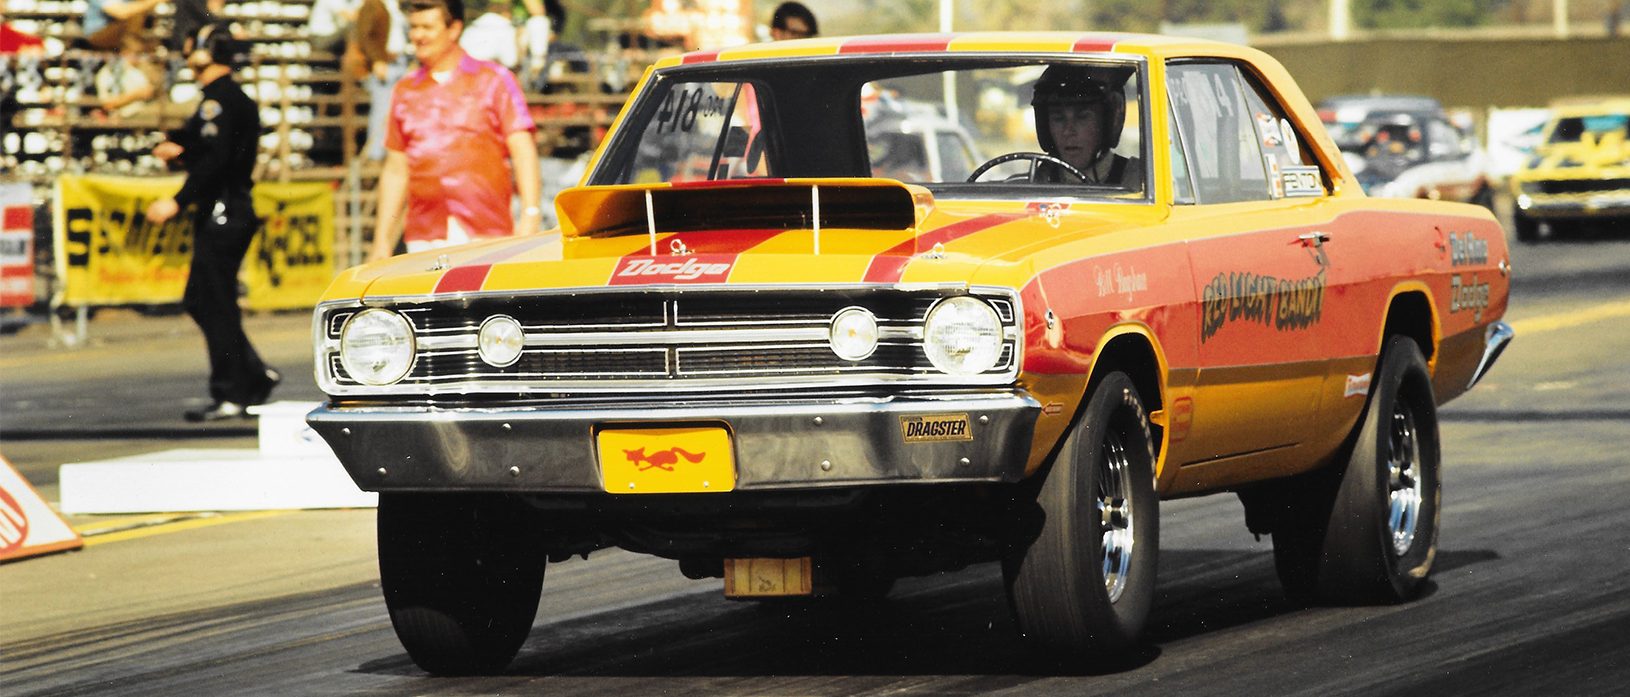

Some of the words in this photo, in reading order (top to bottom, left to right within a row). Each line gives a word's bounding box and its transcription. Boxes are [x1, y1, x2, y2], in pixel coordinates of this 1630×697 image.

[618, 258, 731, 280] Dodge
[1201, 271, 1228, 345] RED
[1229, 271, 1277, 328] LIGHT
[1276, 268, 1327, 332] BANDIT
[1450, 273, 1490, 324] Dodge
[906, 419, 967, 437] DRAGSTER
